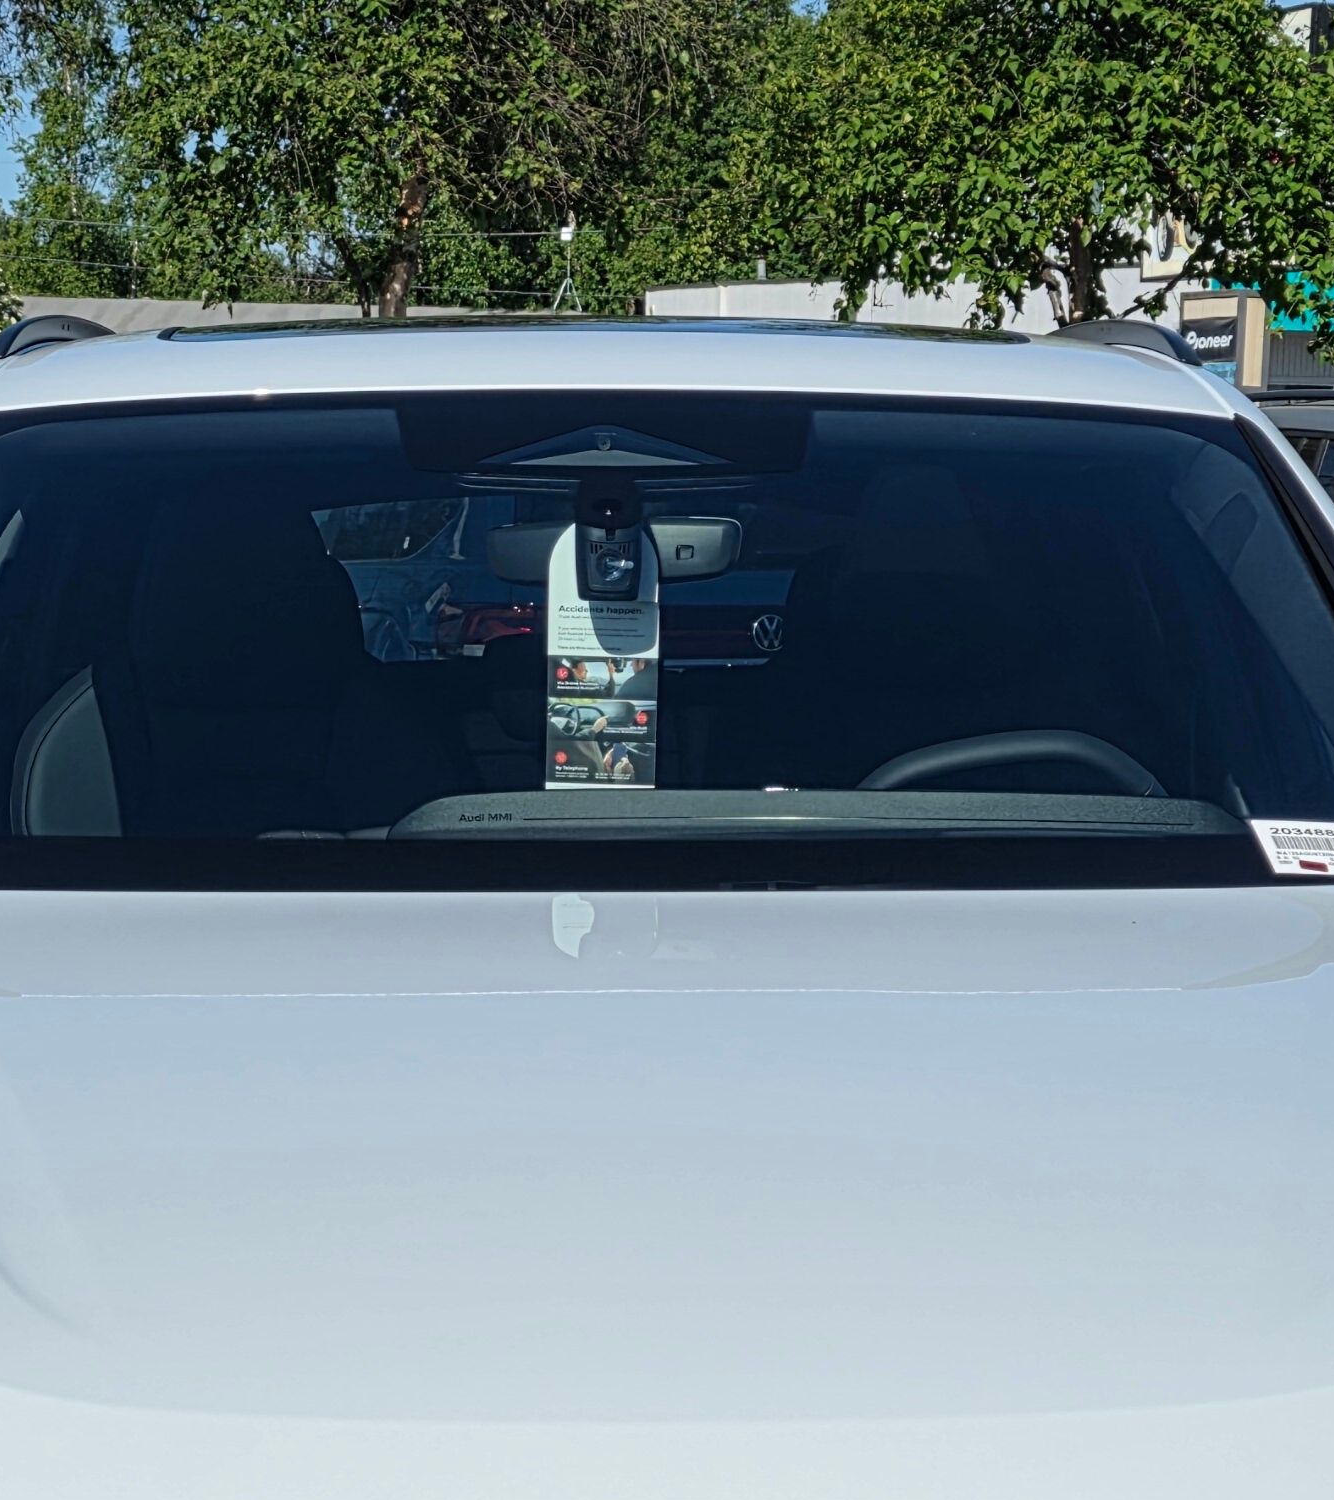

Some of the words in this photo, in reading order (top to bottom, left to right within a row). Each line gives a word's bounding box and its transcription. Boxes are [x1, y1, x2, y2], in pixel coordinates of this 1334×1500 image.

[1186, 330, 1234, 350] Pioneer
[558, 604, 604, 613] Accidents
[459, 813, 485, 822] Audi
[488, 813, 513, 821] MMI
